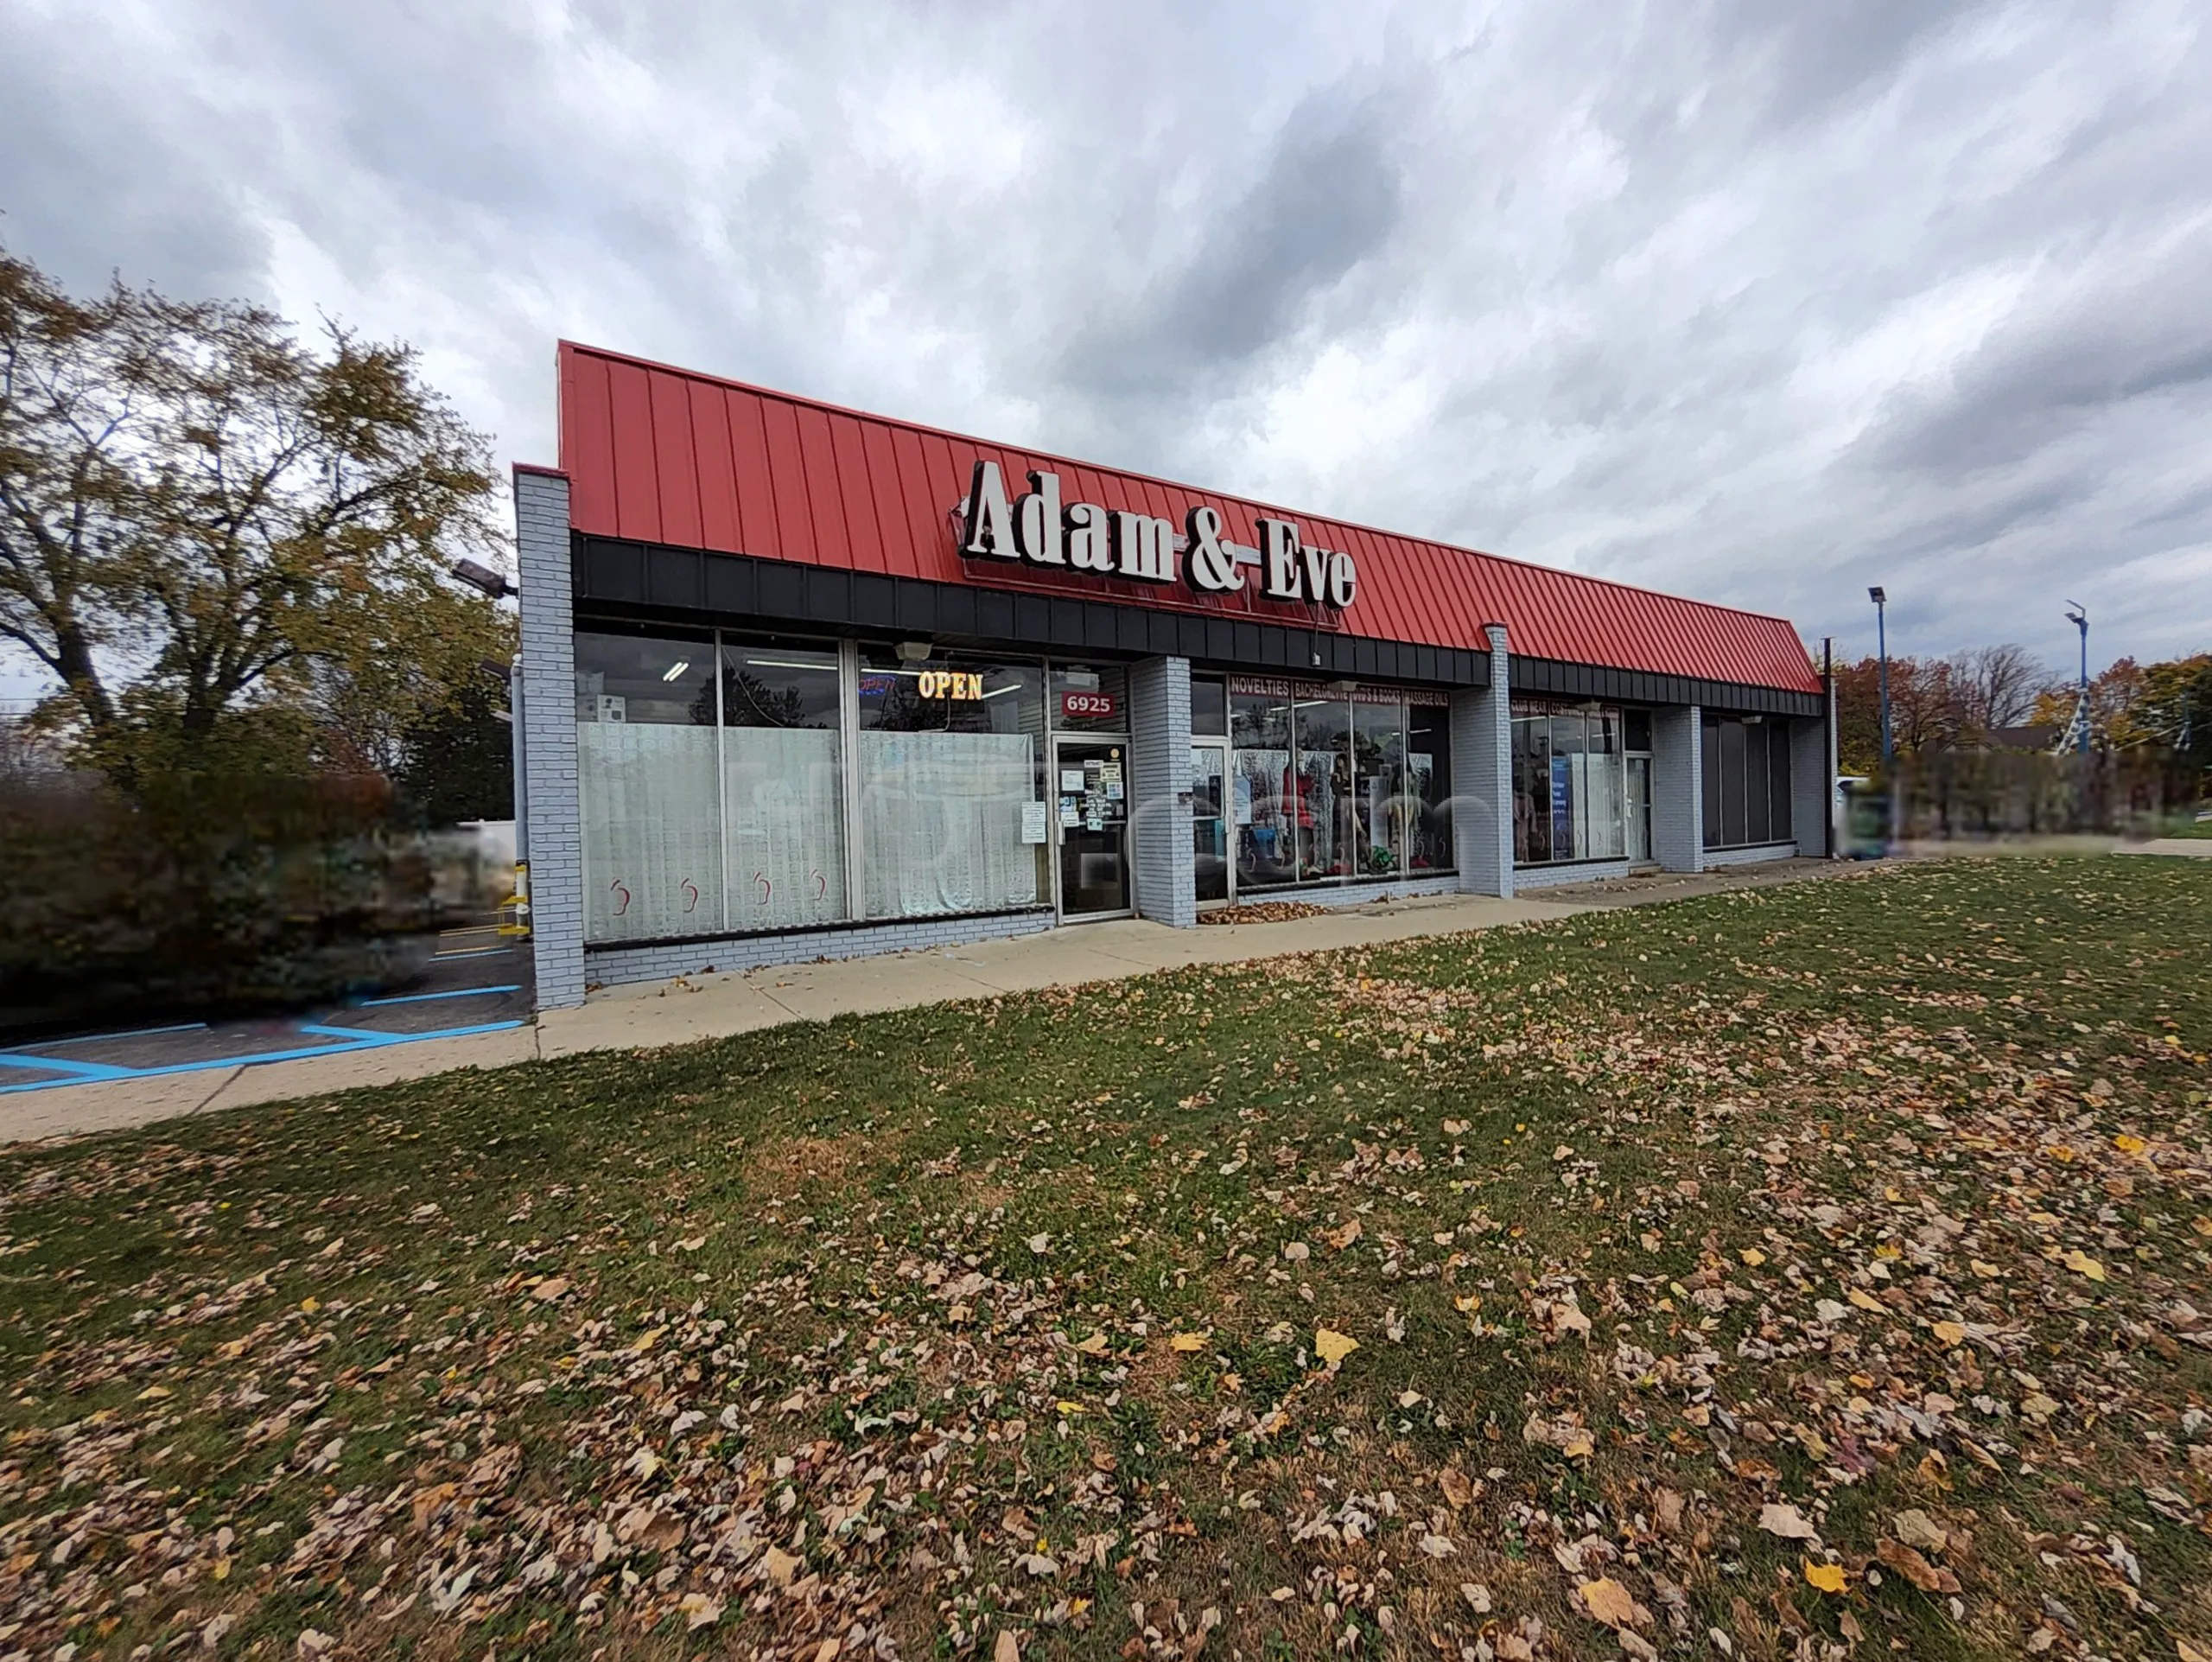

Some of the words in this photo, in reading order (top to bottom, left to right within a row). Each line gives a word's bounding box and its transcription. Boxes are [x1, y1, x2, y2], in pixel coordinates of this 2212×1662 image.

[959, 461, 1177, 584] Adam
[1184, 506, 1246, 594] &
[1255, 518, 1357, 608] Eve
[918, 672, 983, 700] OPEN
[1231, 677, 1289, 697] NOVELTIES
[1067, 695, 1110, 713] 6925
[1403, 691, 1433, 705] MASSAGE
